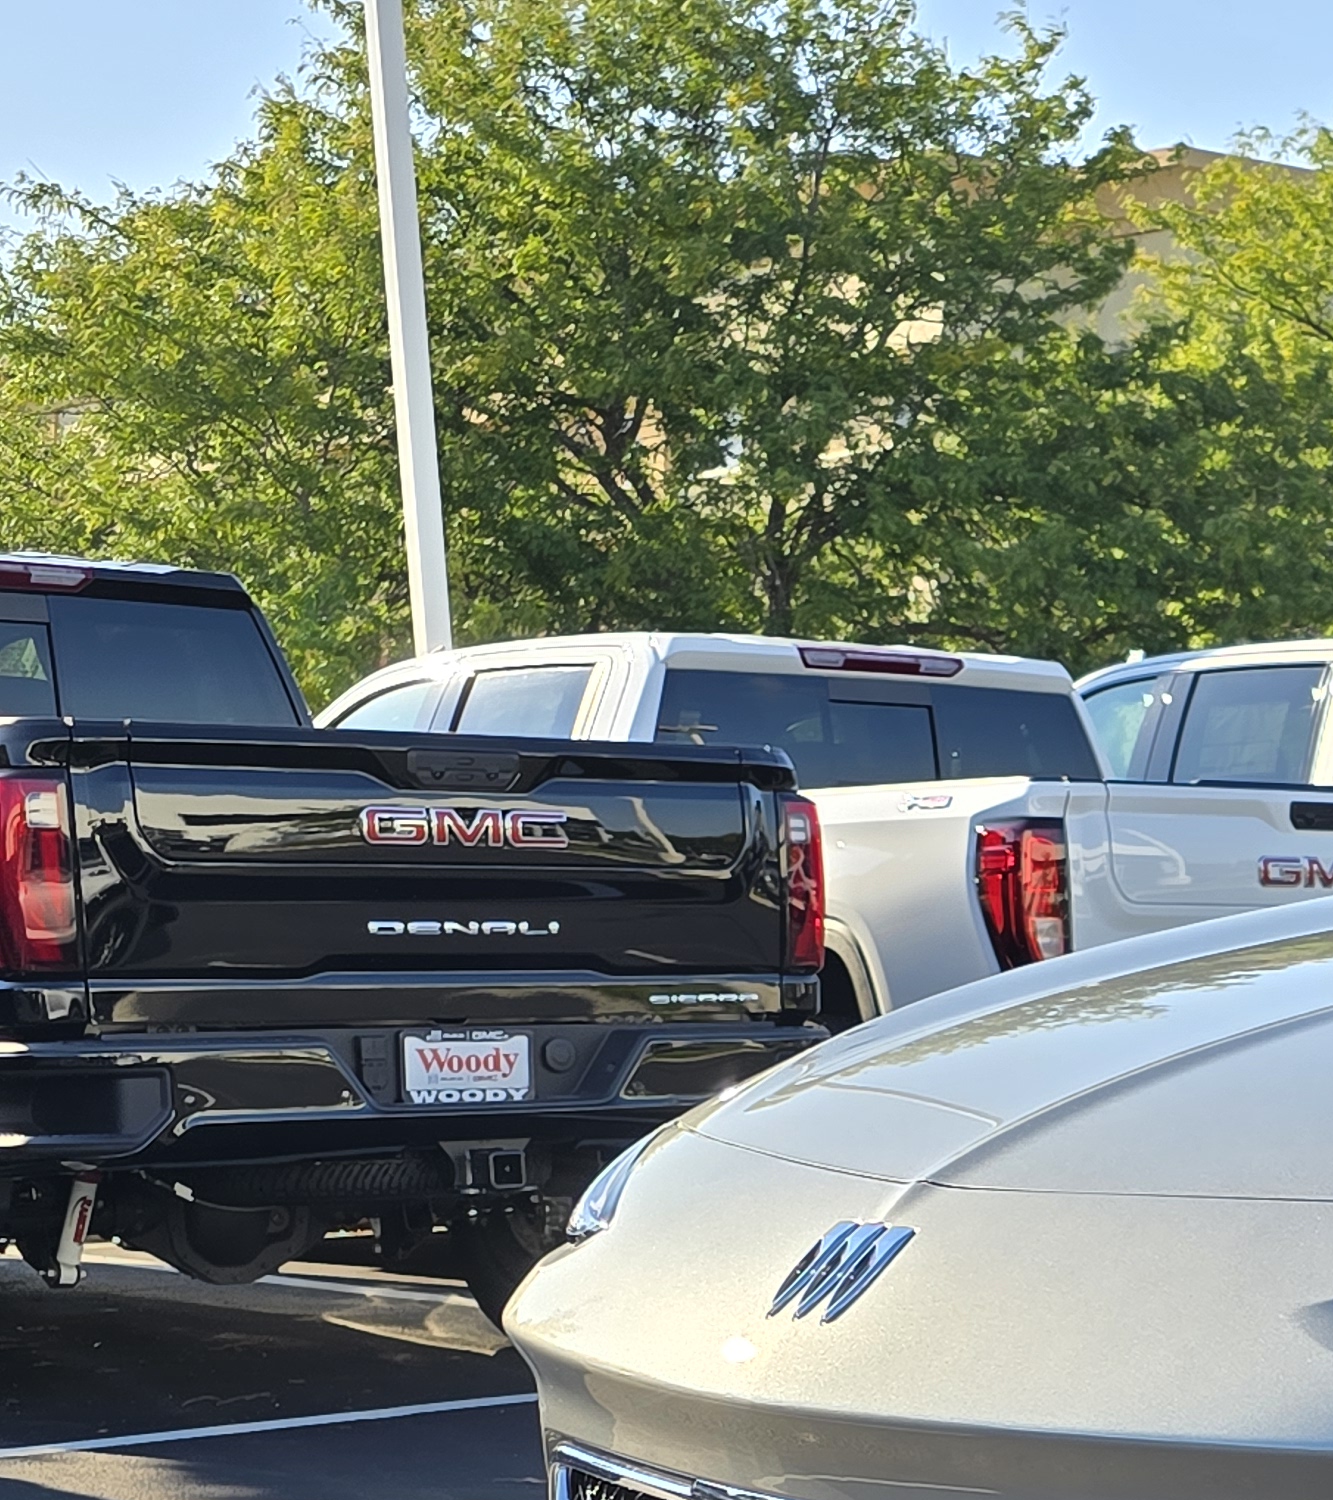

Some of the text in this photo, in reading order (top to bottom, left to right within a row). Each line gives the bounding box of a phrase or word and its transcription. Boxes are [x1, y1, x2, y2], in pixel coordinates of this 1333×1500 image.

[359, 806, 569, 848] GMC
[367, 921, 560, 935] DENALI
[415, 1047, 519, 1078] Woody
[410, 1088, 529, 1104] WOODY
